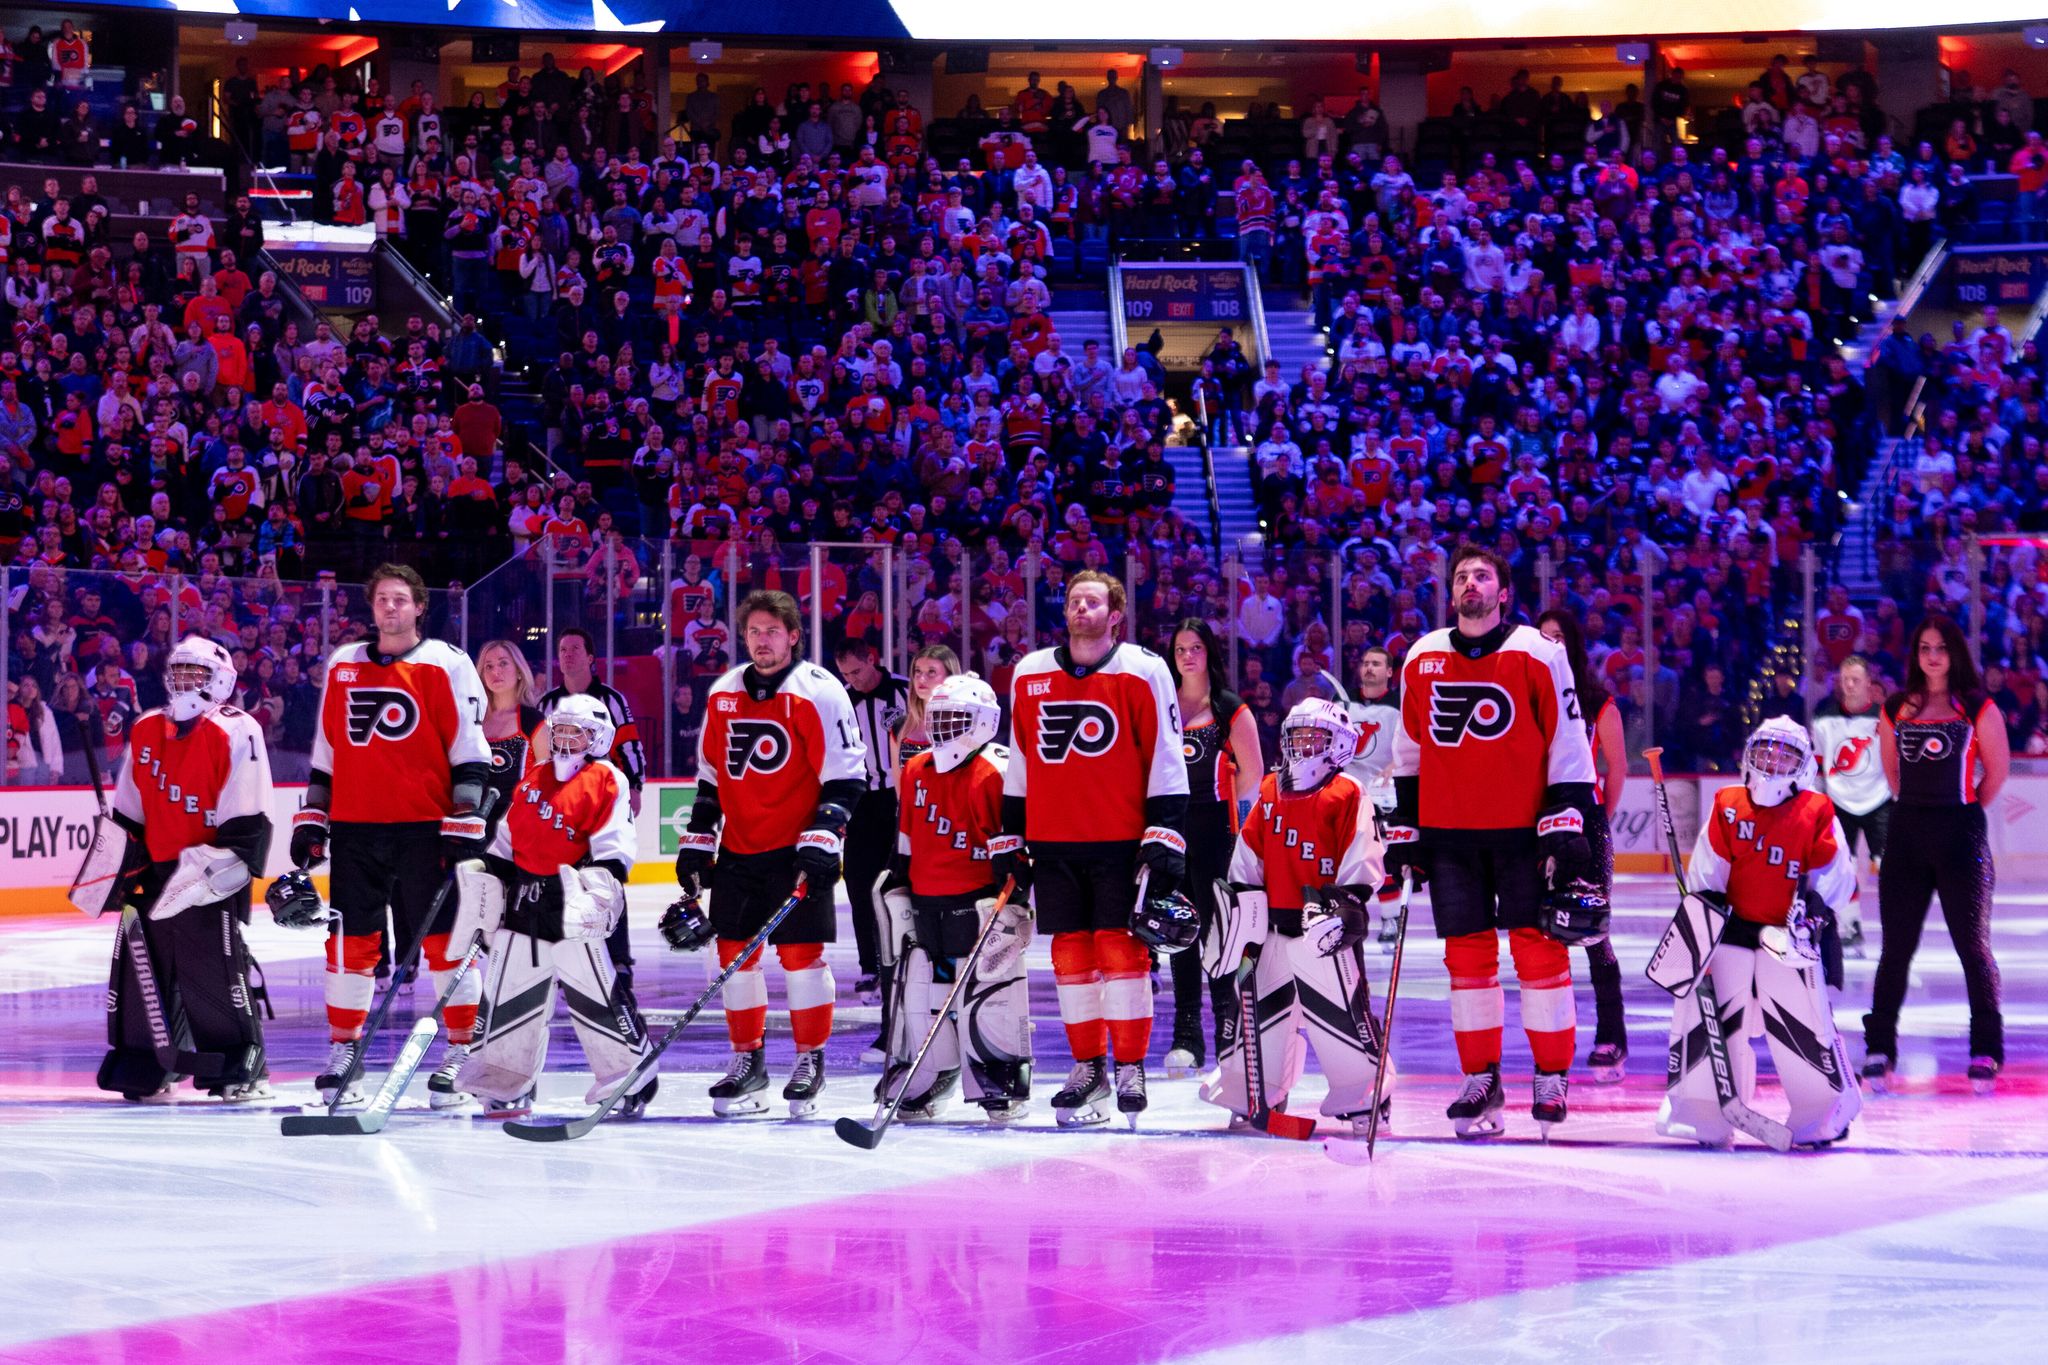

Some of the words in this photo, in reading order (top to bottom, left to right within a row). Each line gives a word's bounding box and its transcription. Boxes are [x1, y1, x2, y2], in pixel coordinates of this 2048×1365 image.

[297, 258, 331, 277] Rock
[1958, 258, 1996, 274] Hard
[1997, 256, 2031, 276] Rock
[1126, 274, 1162, 290] Hard
[1163, 274, 1198, 292] Rock
[345, 286, 372, 304] 109
[1958, 285, 1987, 301] 108
[1126, 301, 1153, 317] 109
[1172, 303, 1191, 317] EXIT
[1211, 300, 1240, 317] 108
[1419, 658, 1446, 675] IBX
[1027, 679, 1051, 697] IBX
[248, 734, 259, 762] 1
[1539, 816, 1582, 832] CCM
[0, 816, 63, 859] PLAY
[66, 824, 90, 851] TO
[679, 833, 716, 847] AUER
[798, 833, 835, 849] AUER
[1261, 801, 1335, 876] NIDER
[1385, 830, 1413, 841] CM
[1724, 807, 1801, 880] SNIDE
[989, 838, 1018, 854] UER
[1147, 919, 1161, 930] 8
[1556, 910, 1571, 928] 27
[1650, 930, 1675, 973] CCM
[130, 940, 170, 1048] WARRIOR
[1241, 990, 1260, 1098] WARRIOR
[1700, 995, 1733, 1098] BAUER
